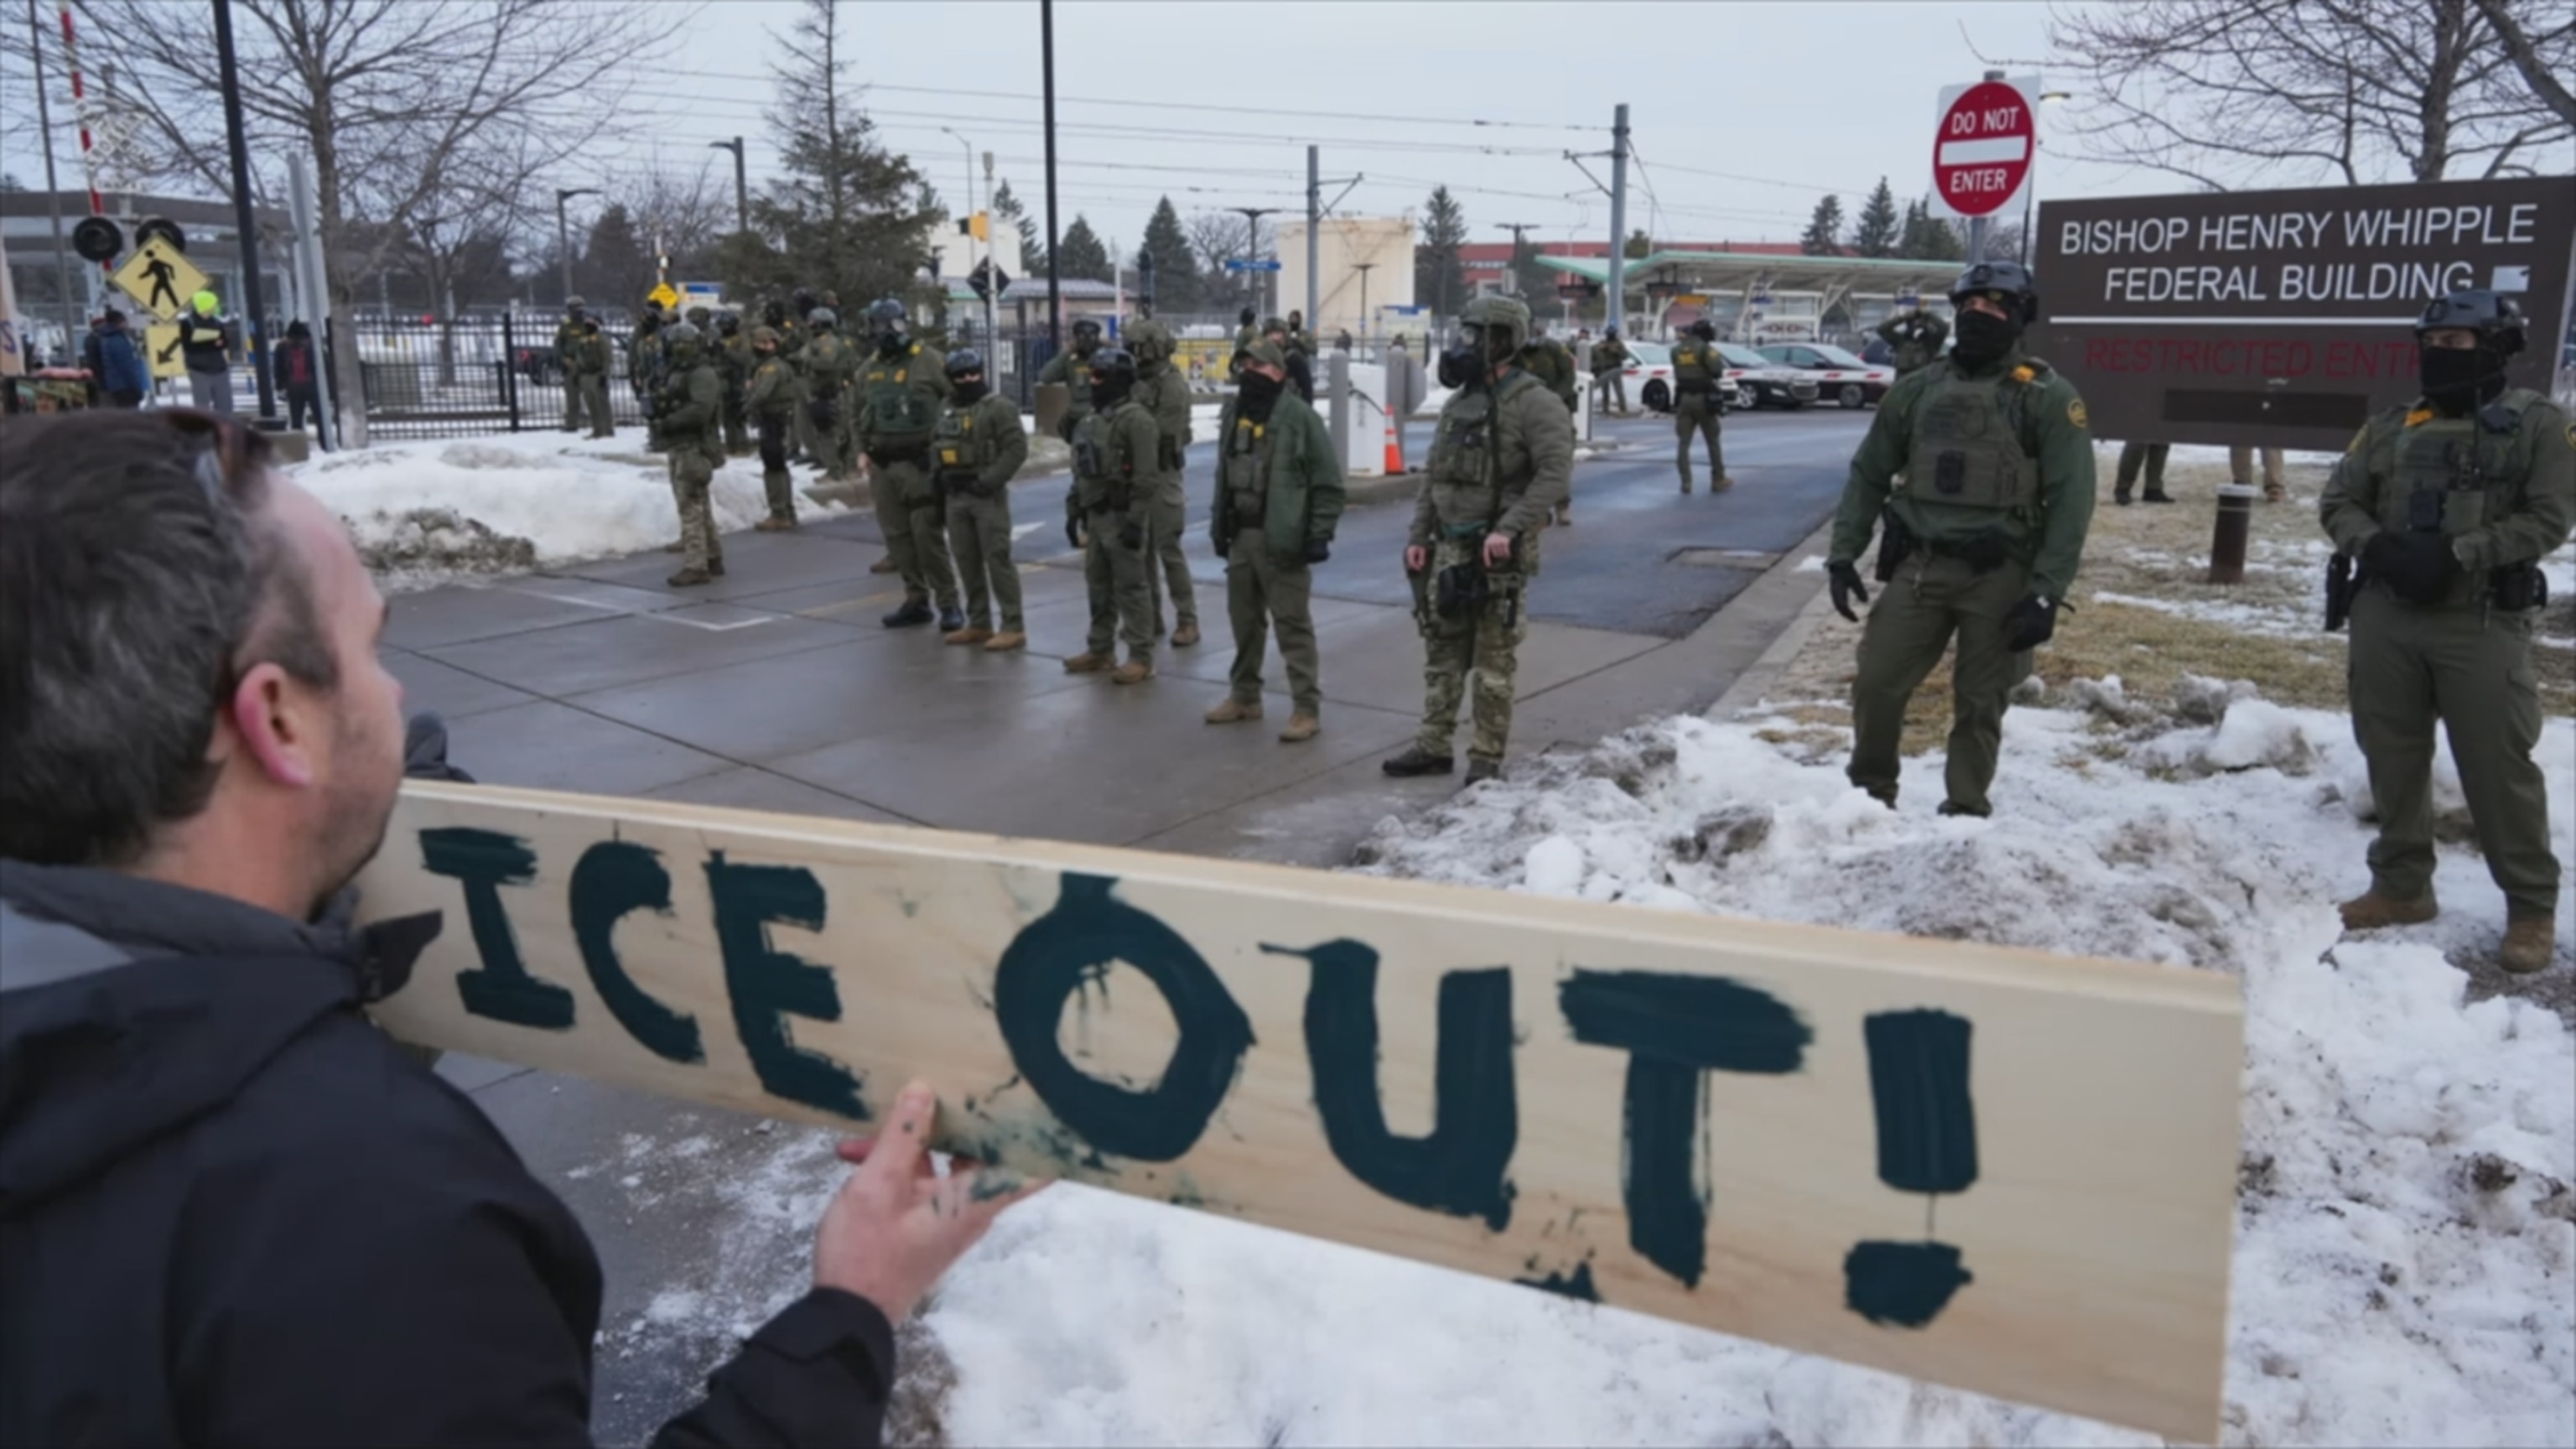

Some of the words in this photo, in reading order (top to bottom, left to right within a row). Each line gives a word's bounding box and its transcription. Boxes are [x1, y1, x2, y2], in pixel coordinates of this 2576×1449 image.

[1950, 110, 1977, 135] DO
[1982, 106, 2021, 132] NOT
[1950, 168, 2008, 194] ENTER
[2060, 216, 2189, 254] BISHOP
[2198, 211, 2333, 251] HENRY
[2345, 204, 2537, 247] WHIPPLE
[2104, 265, 2267, 302] FEDERAL
[2278, 261, 2474, 300] BUILDING
[2084, 336, 2315, 378] RESTRICTED
[2324, 340, 2423, 379] ENT
[418, 823, 873, 1122] ICE
[995, 872, 1979, 1329] OUT!
